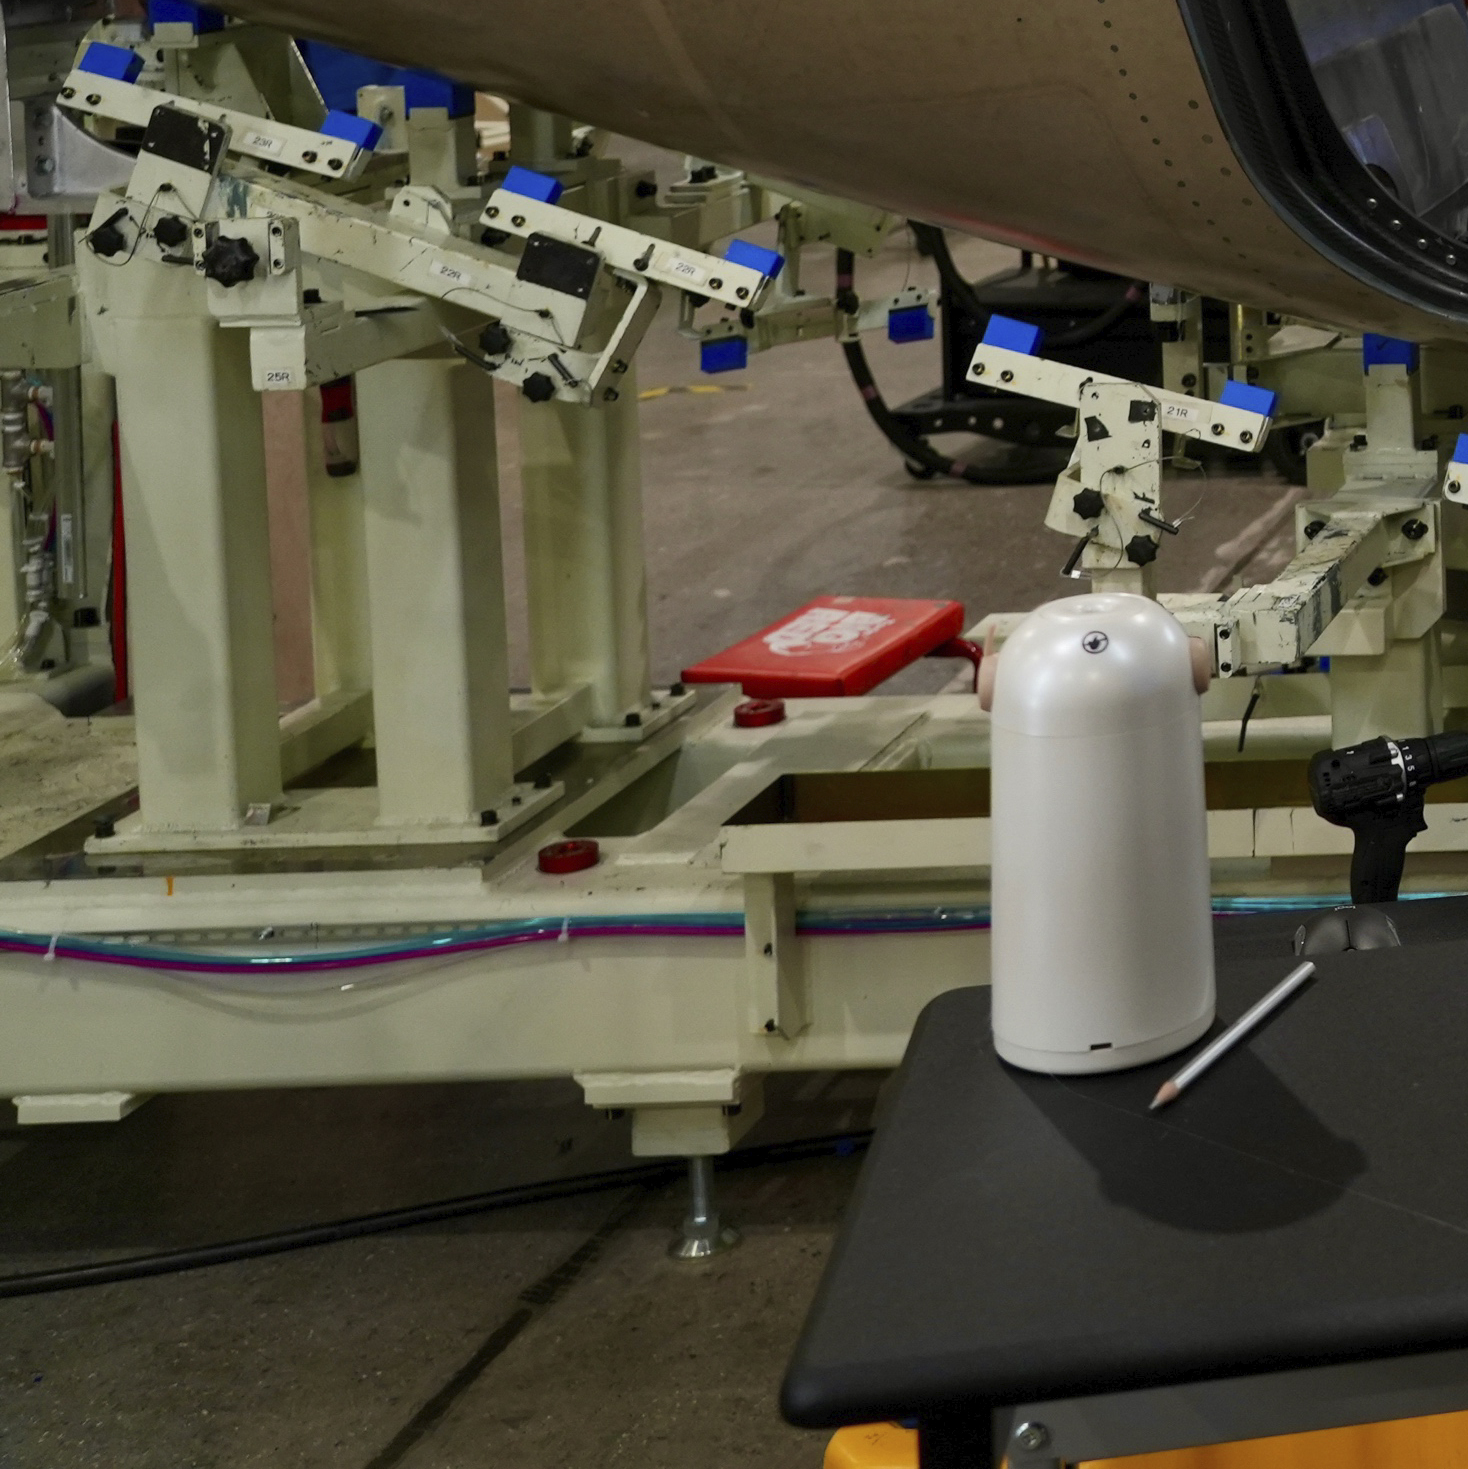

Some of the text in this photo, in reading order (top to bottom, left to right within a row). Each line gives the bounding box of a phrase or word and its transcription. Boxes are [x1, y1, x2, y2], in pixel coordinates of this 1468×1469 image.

[439, 265, 462, 282] 22R
[267, 372, 290, 382] 25R
[1166, 405, 1189, 418] 21R
